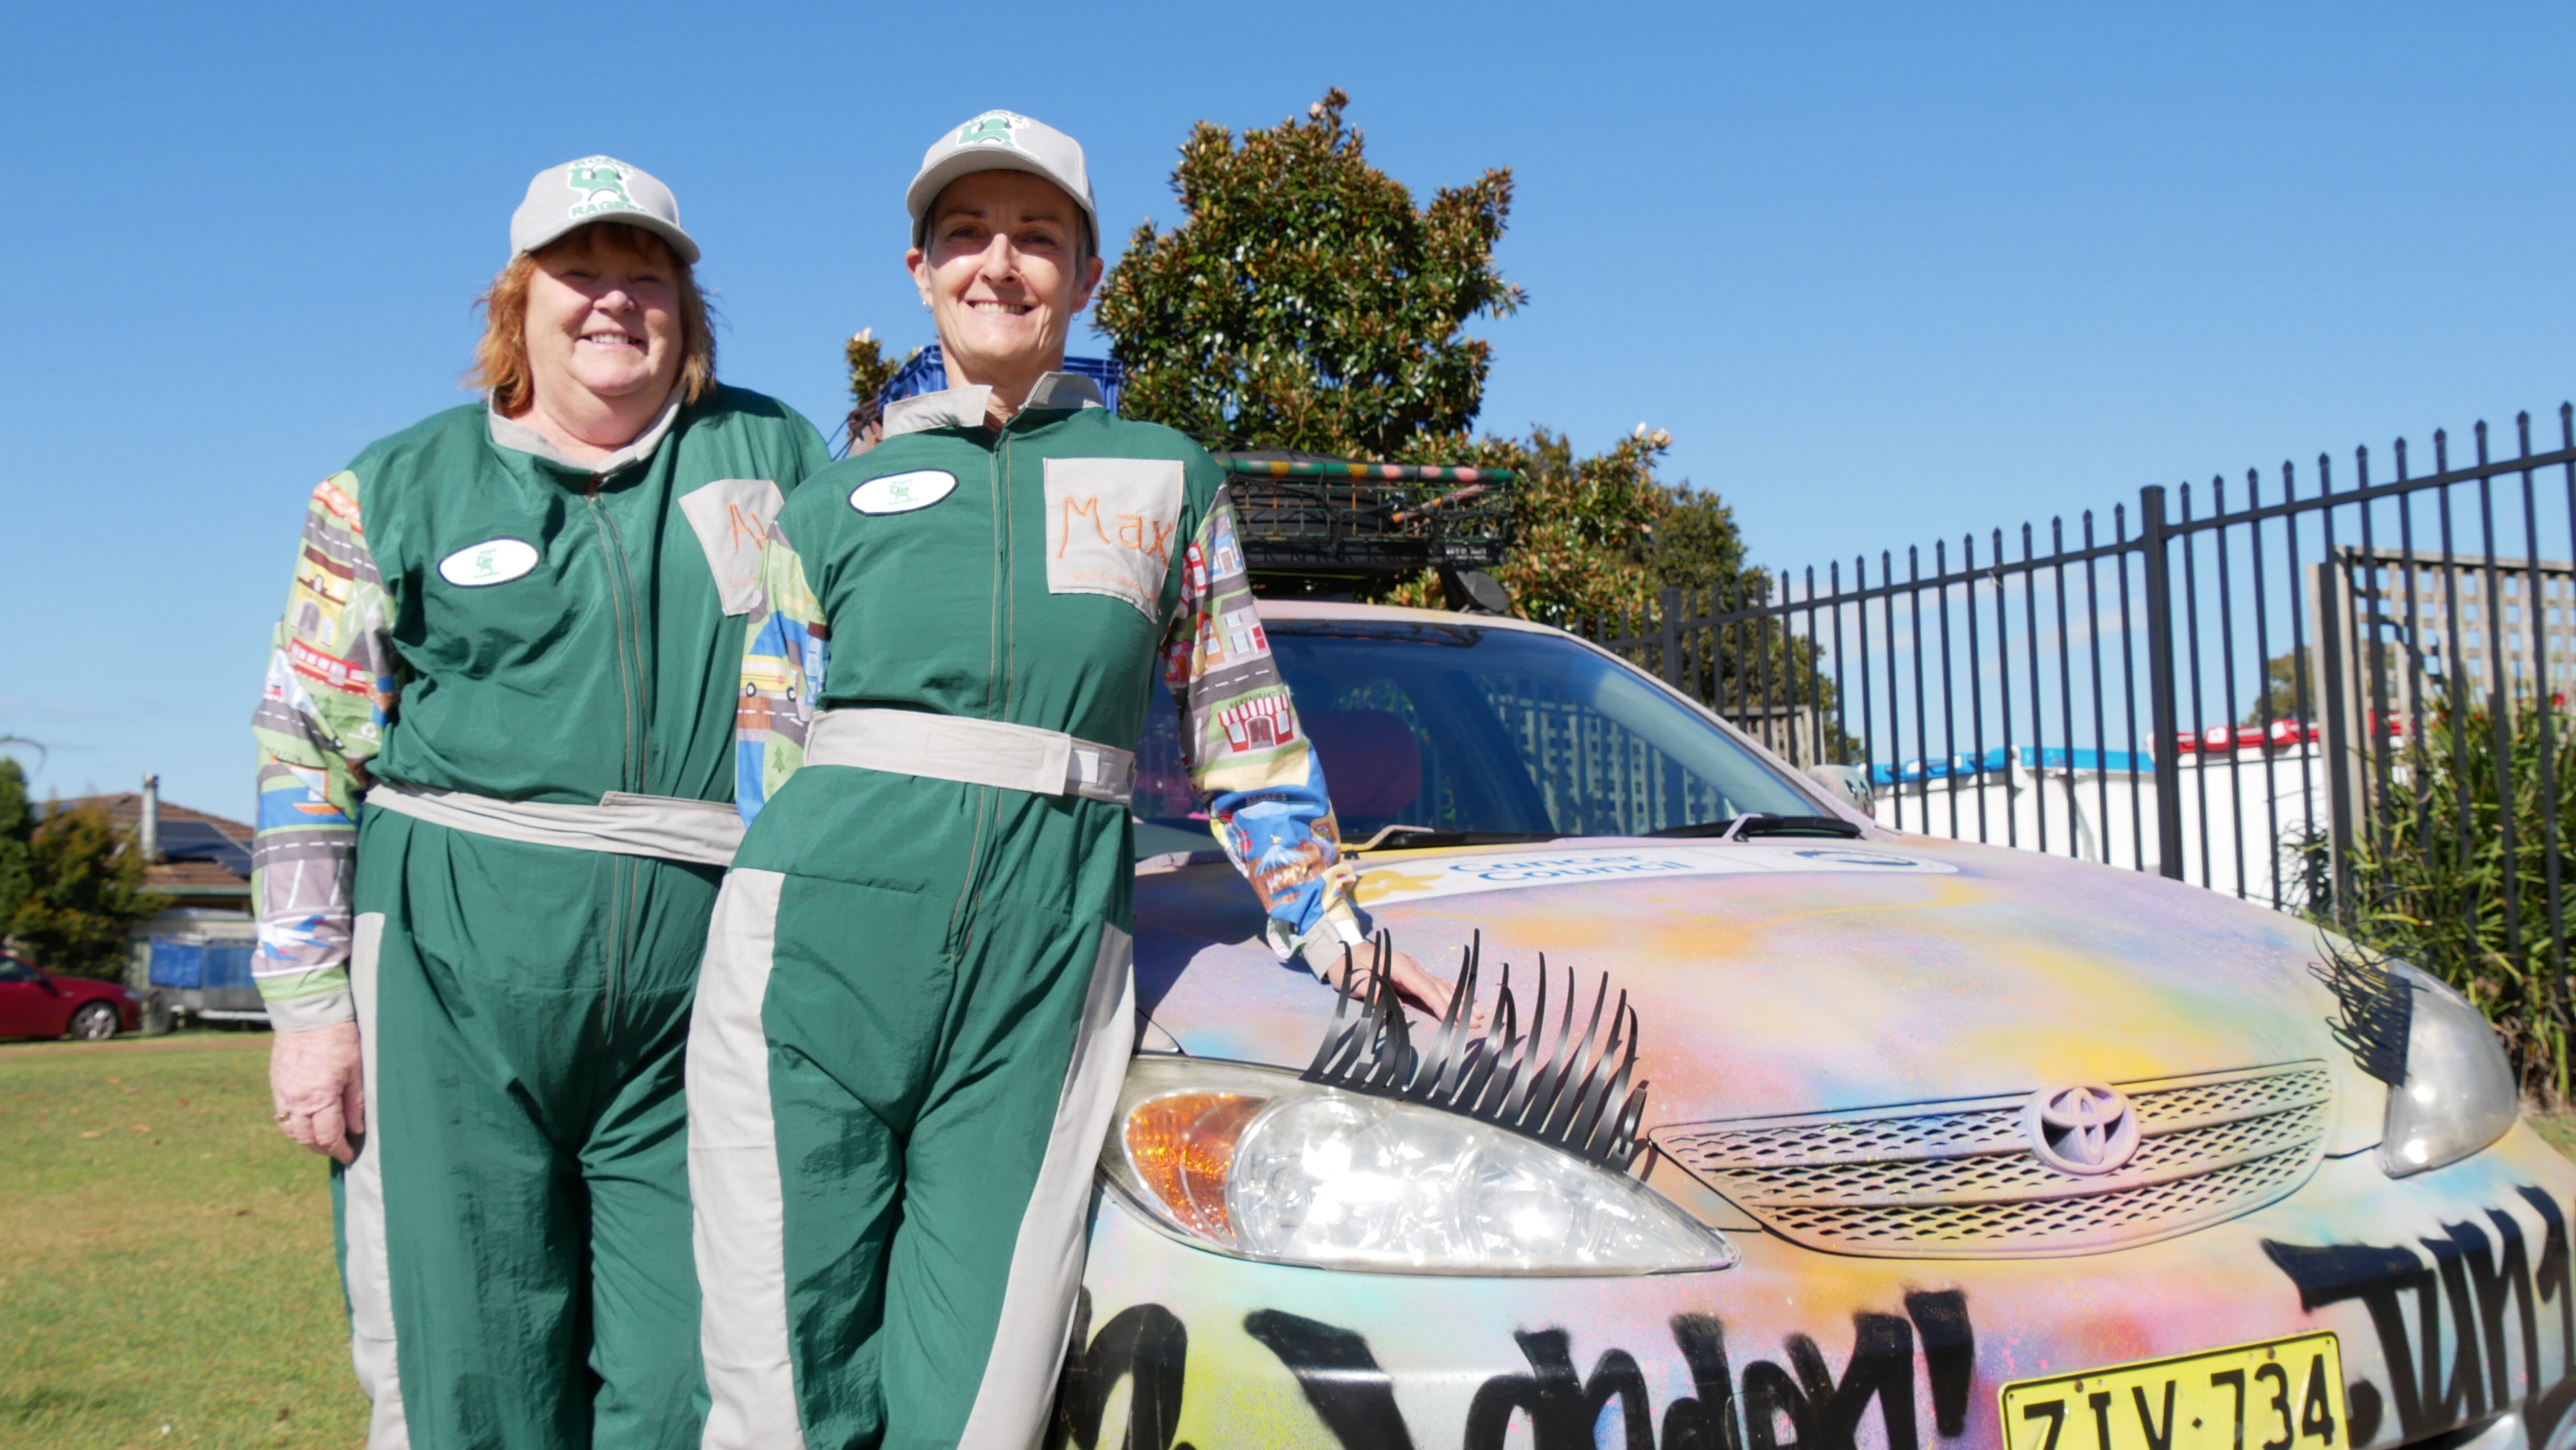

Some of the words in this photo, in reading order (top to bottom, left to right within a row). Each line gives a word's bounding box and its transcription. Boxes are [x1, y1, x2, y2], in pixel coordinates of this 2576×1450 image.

[1057, 495, 1172, 567] Max
[1229, 691, 1276, 708] RESTAURANT
[1448, 855, 1643, 872] Cancer
[1478, 860, 1695, 881] Council
